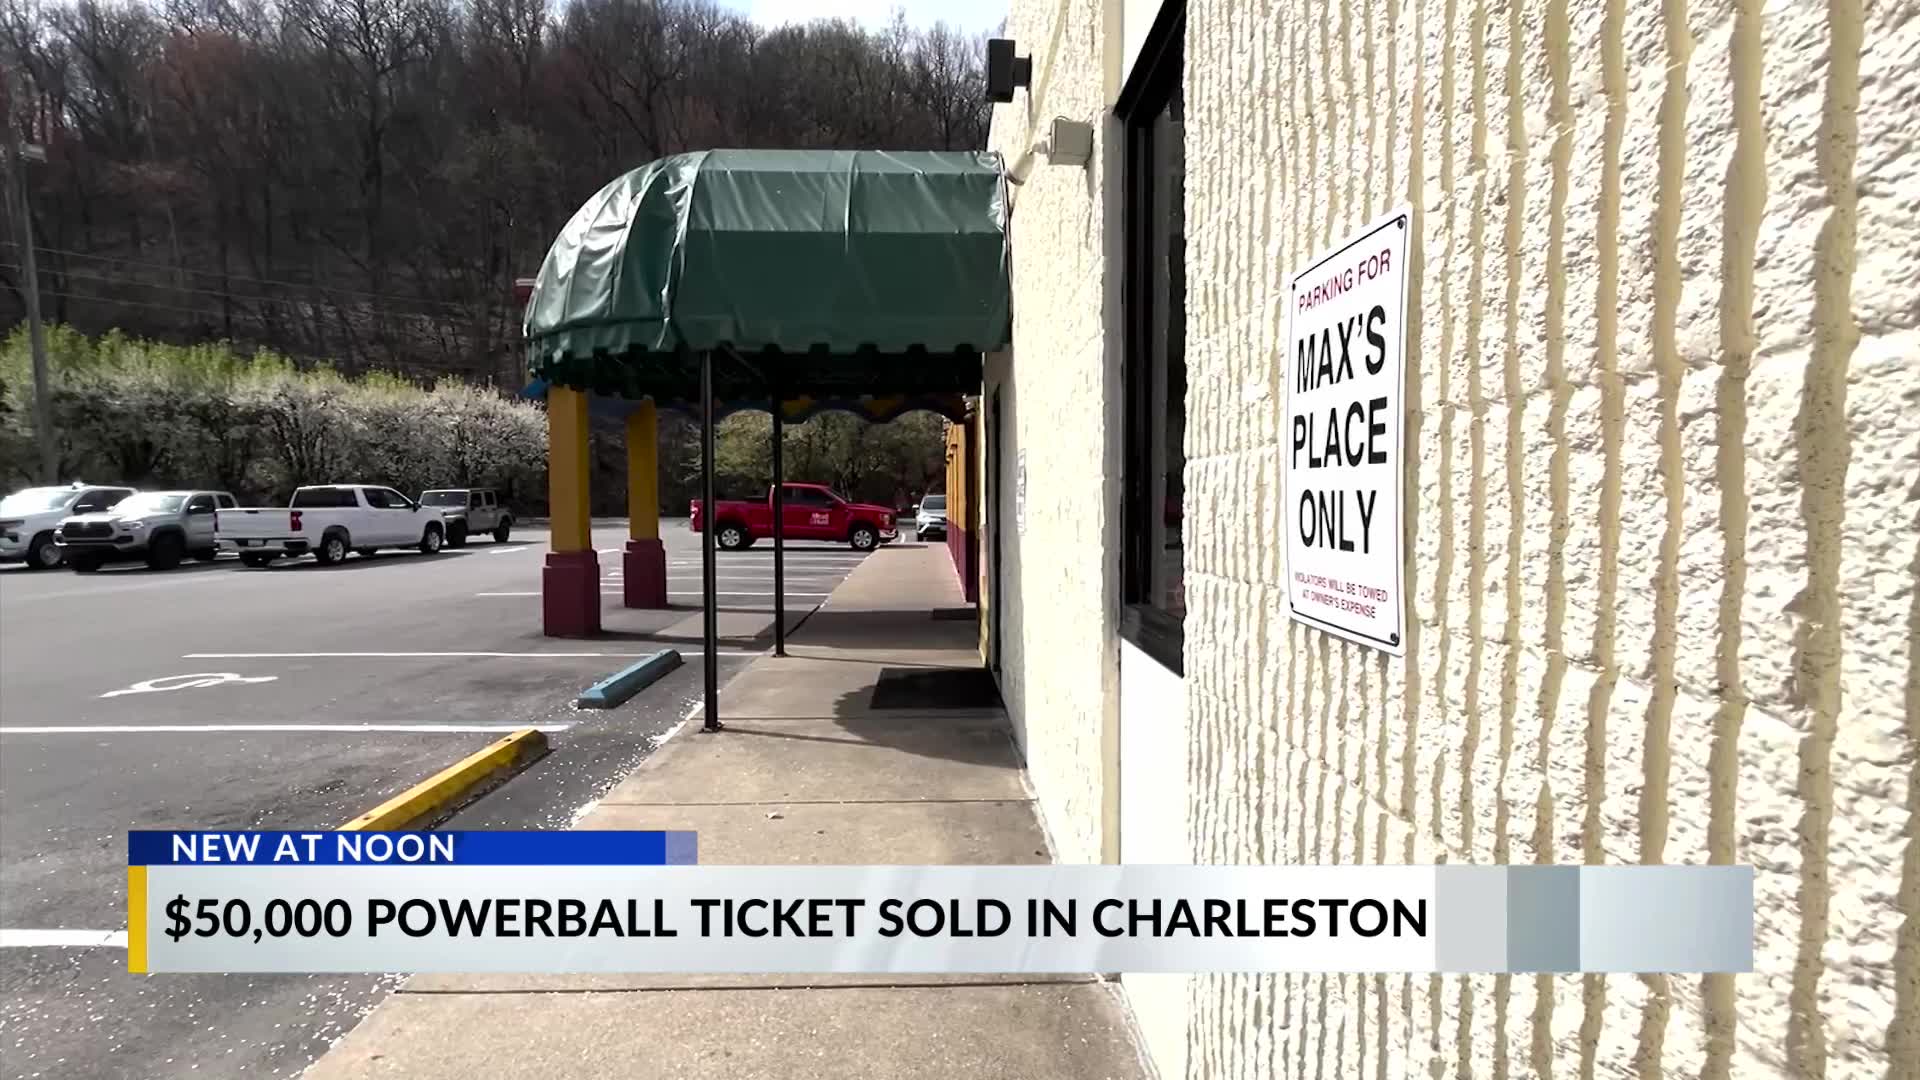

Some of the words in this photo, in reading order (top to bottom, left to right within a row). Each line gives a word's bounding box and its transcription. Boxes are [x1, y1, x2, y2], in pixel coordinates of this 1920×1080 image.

[1298, 267, 1353, 315] PARKING
[1358, 248, 1391, 286] FOR
[1296, 304, 1386, 394] MAX'S
[1293, 396, 1388, 470] PLACE
[1299, 488, 1377, 554] ONLY
[1294, 571, 1327, 589] VIOLATORS
[1328, 578, 1344, 593] WILL
[1346, 581, 1356, 596] BE
[1357, 584, 1388, 602] TOWED
[1302, 588, 1310, 599] AT
[1341, 598, 1376, 619] EXPENSE
